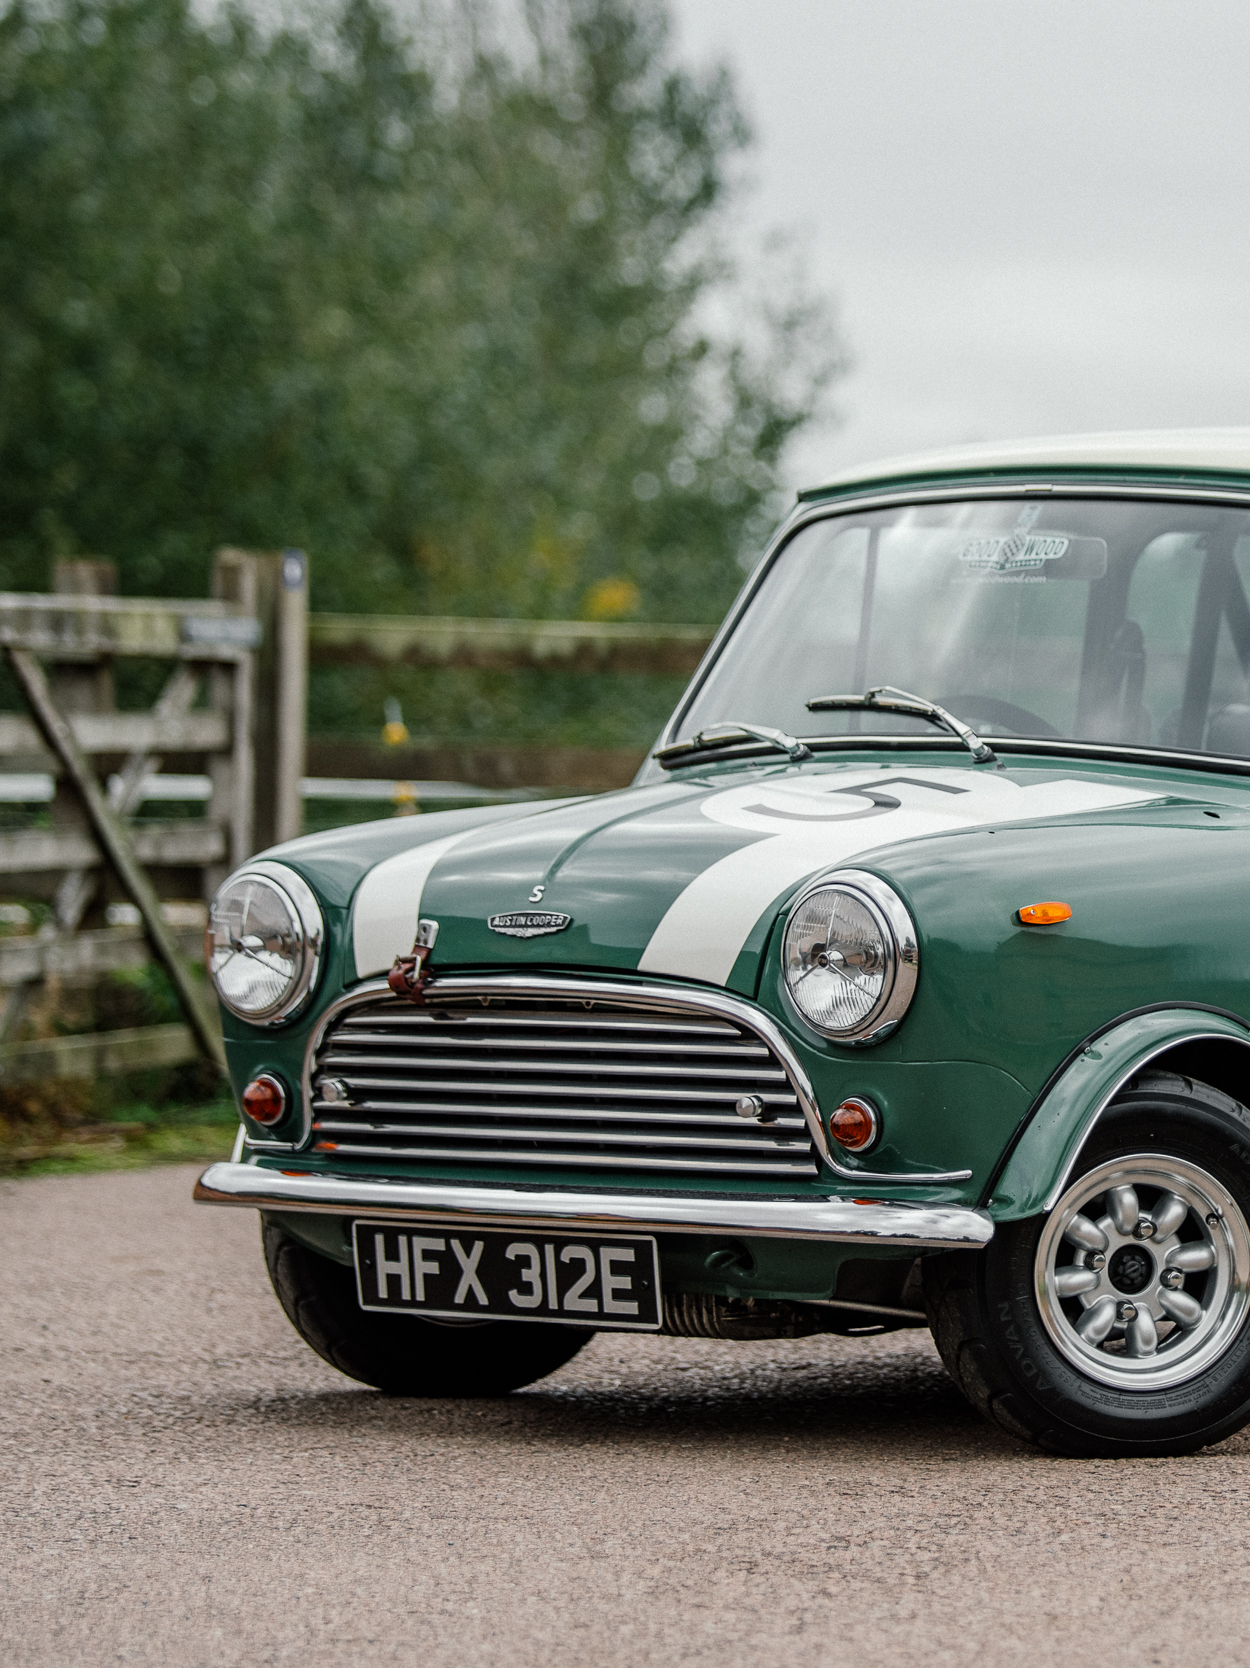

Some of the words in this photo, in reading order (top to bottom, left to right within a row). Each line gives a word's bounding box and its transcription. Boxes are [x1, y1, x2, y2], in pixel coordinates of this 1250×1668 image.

[1023, 539, 1064, 557] WOOD
[741, 777, 971, 822] 5
[528, 885, 546, 903] S
[492, 916, 526, 926] AUSTIN
[527, 916, 564, 926] COOPER
[375, 1232, 490, 1306] HFX
[505, 1240, 640, 1316] 312E
[997, 1301, 1054, 1392] ADVAN
